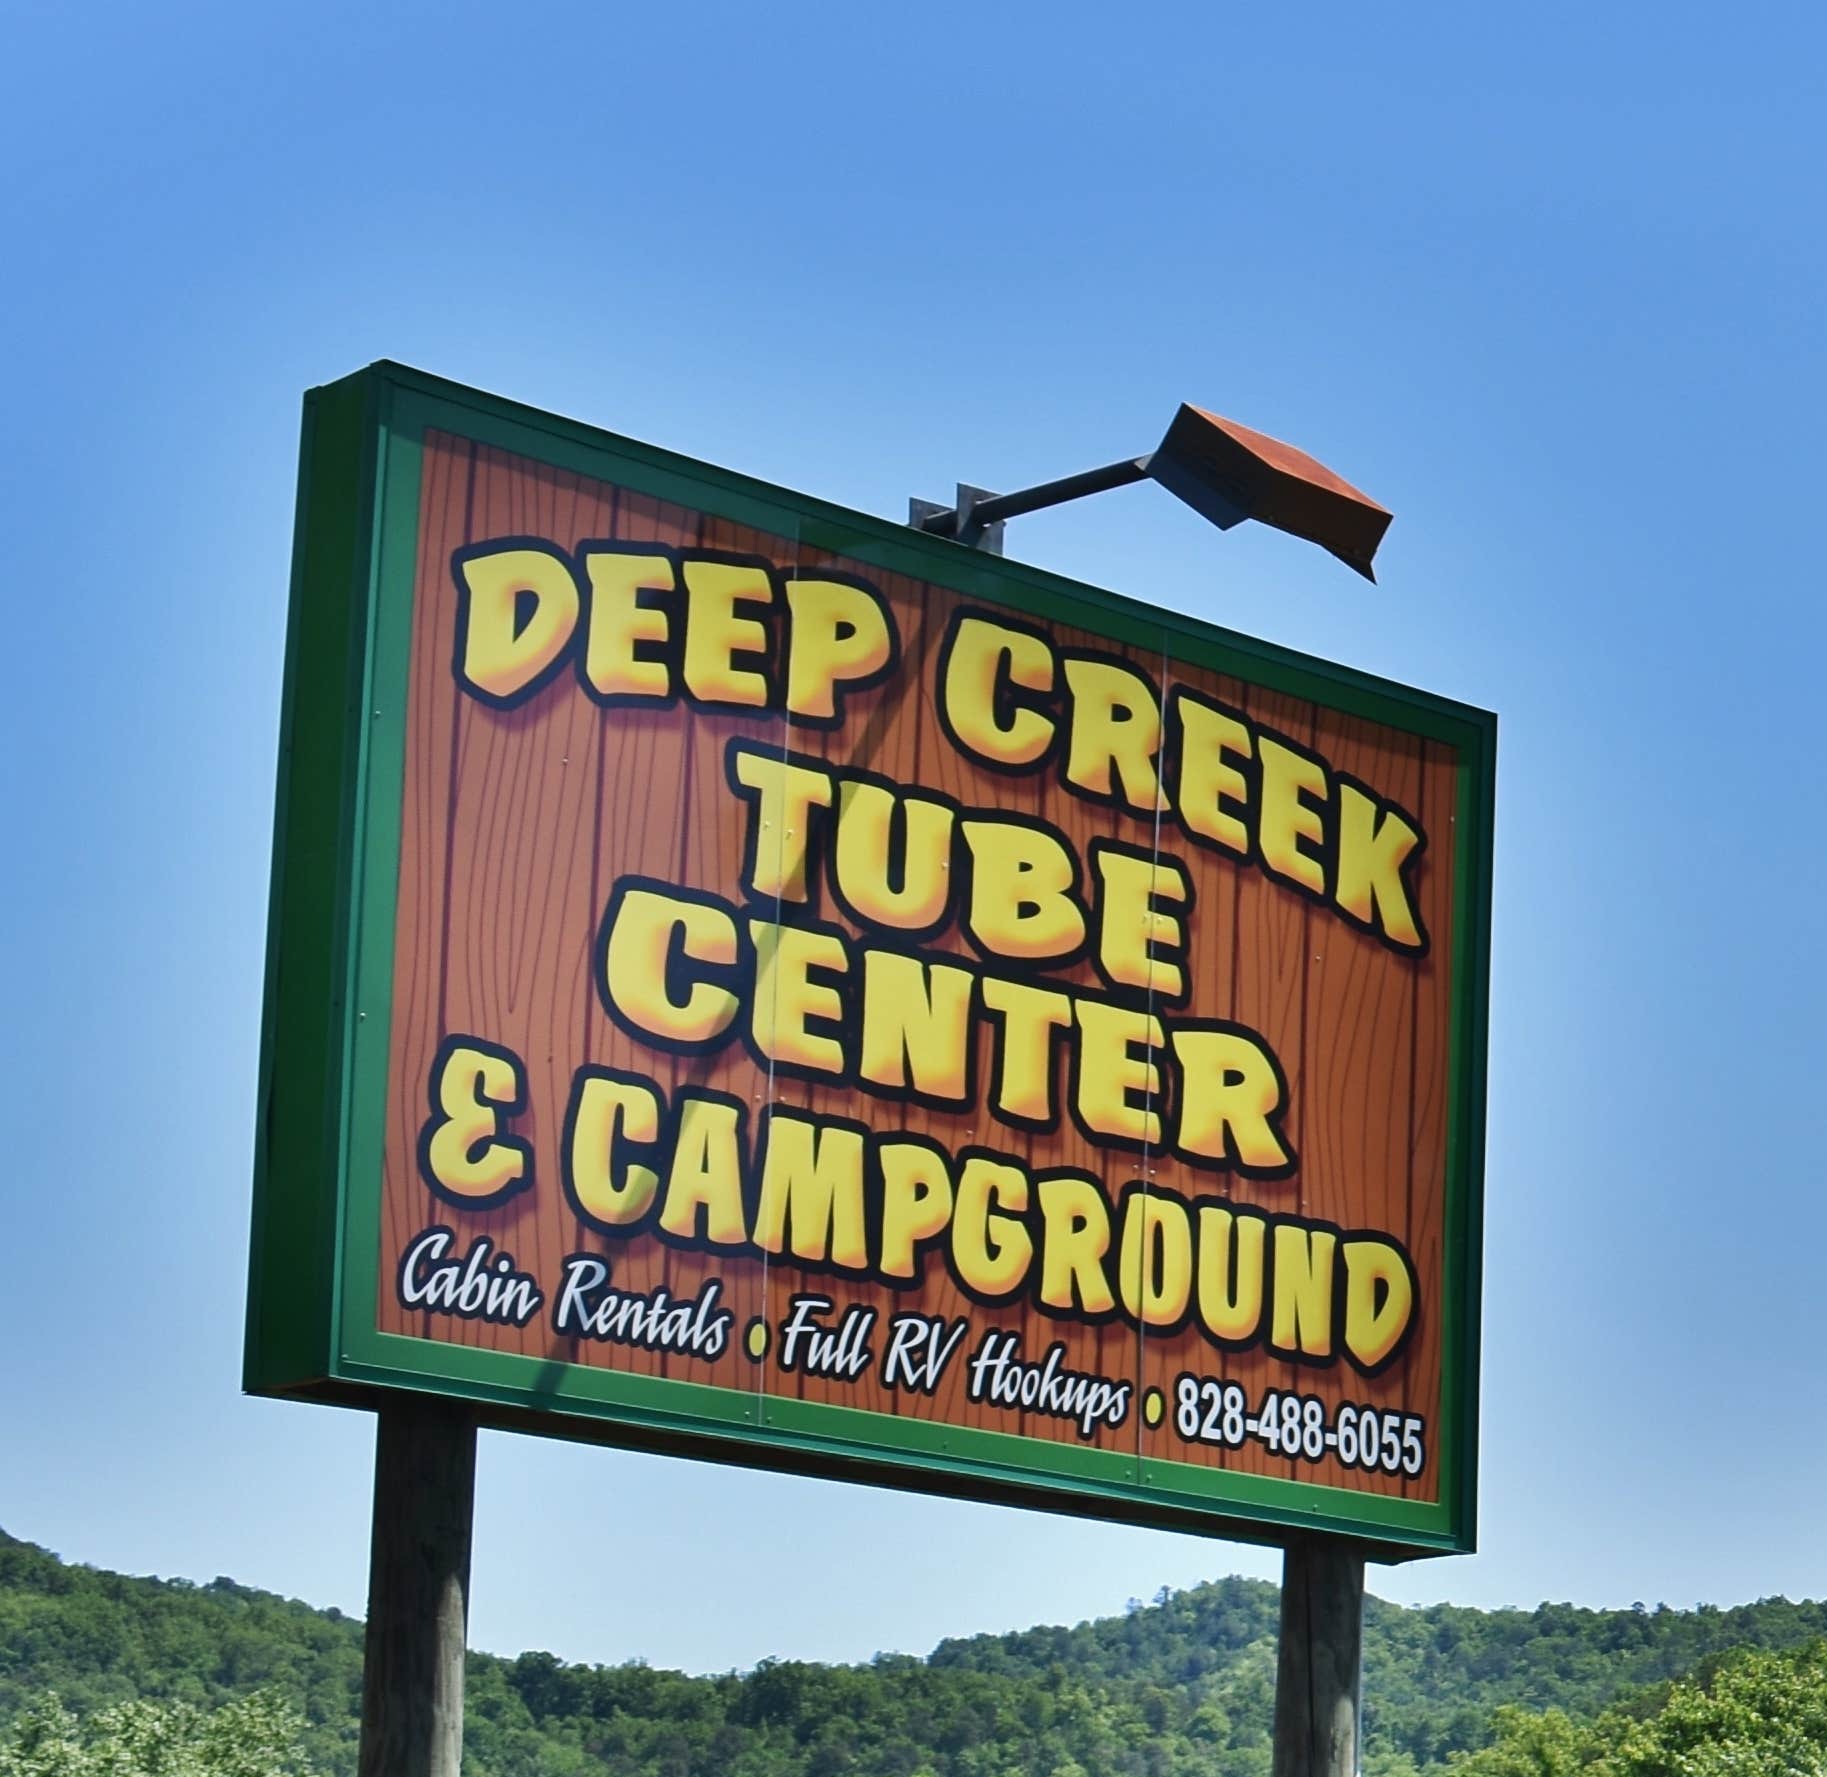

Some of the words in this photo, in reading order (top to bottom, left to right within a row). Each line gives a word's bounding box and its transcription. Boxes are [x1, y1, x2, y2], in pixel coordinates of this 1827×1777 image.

[460, 549, 892, 714] DEEP
[942, 616, 1424, 947] CREEK
[736, 750, 1190, 995] TUBE
[605, 887, 1290, 1167] CENTER
[428, 1046, 525, 1195] &
[572, 1077, 1415, 1368] CAMPGROUND
[402, 1232, 540, 1321] Cabin
[556, 1259, 730, 1356] Rentals
[782, 1299, 874, 1377] Full
[884, 1316, 966, 1393] RV
[971, 1333, 1130, 1434] Hookups
[1176, 1377, 1424, 1475] 828-488-6055
